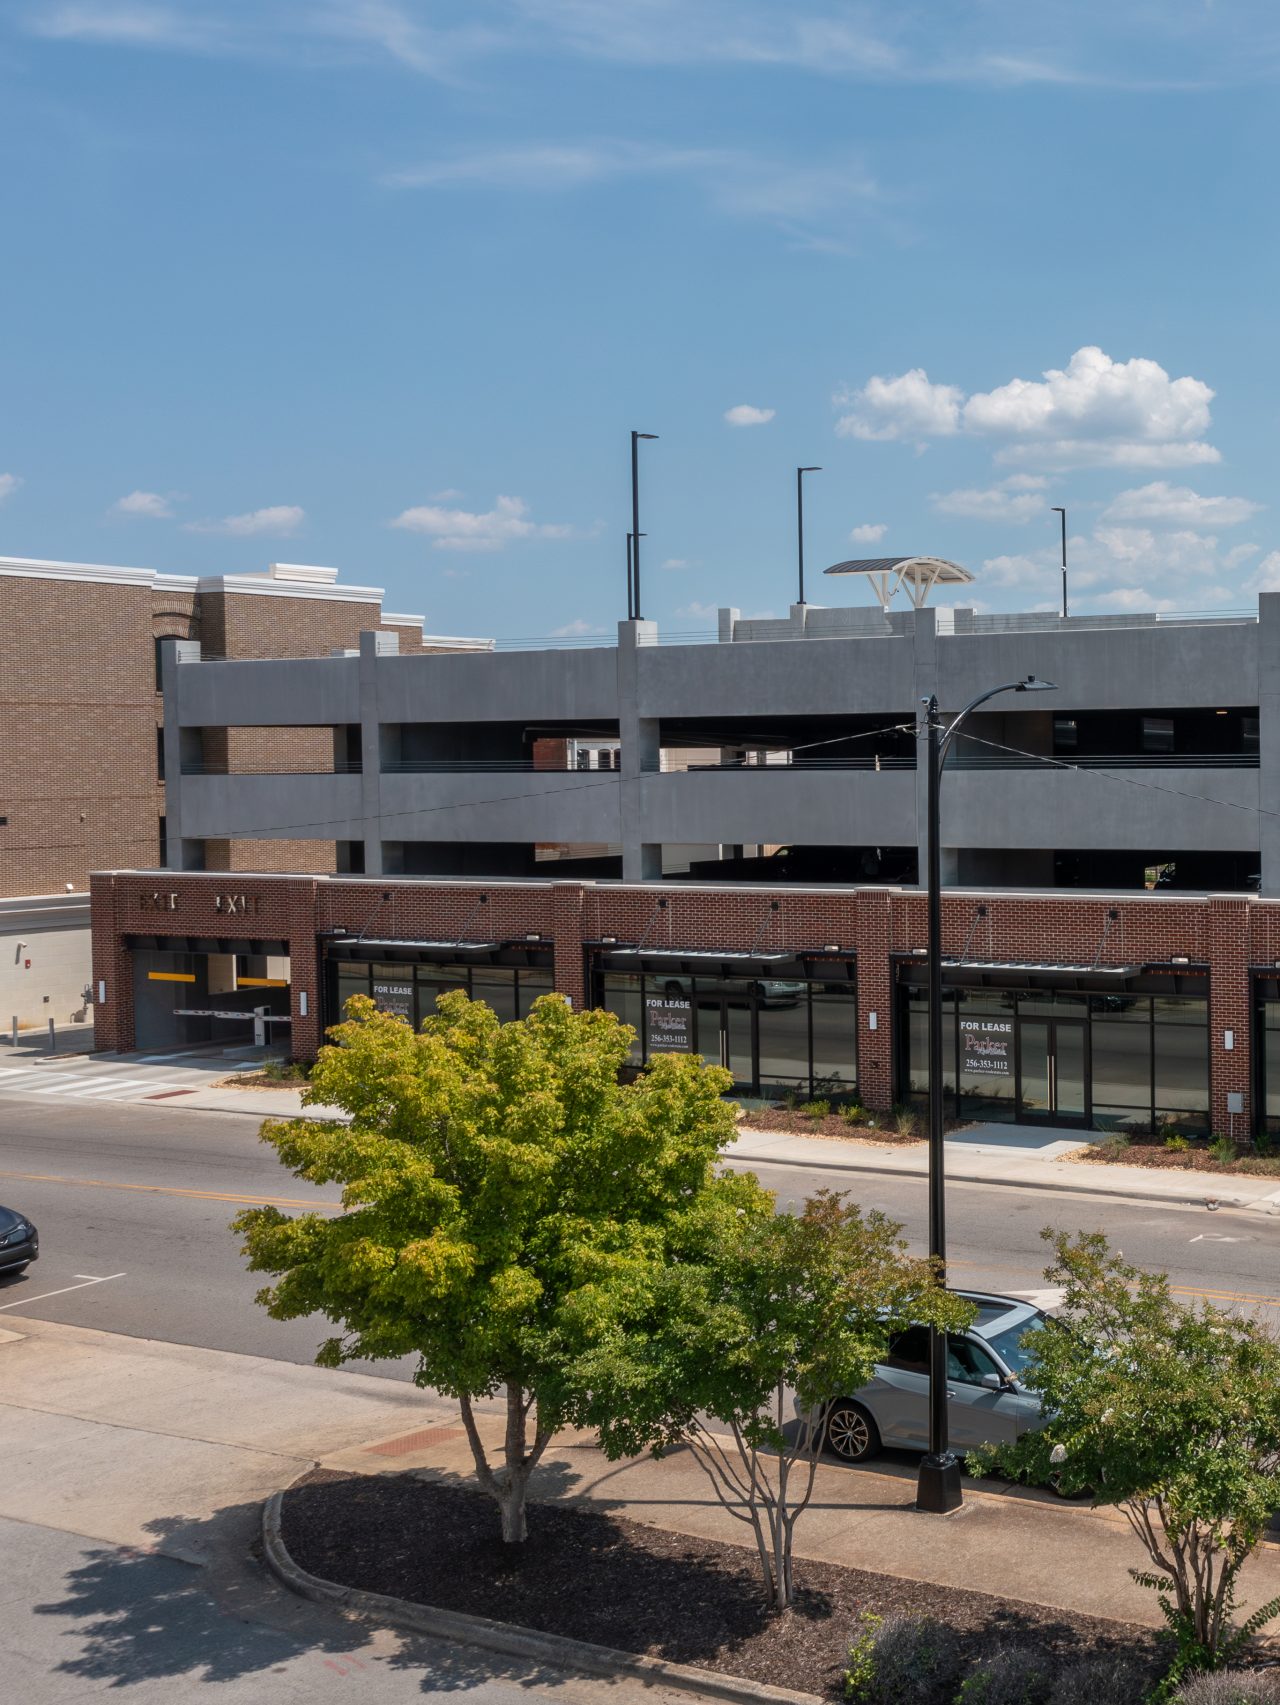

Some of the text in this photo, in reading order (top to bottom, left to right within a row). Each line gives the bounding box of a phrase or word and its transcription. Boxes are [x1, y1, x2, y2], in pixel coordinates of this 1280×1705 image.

[373, 985, 413, 995] FOR LEASE
[646, 999, 691, 1009] FOR LEASE
[650, 1010, 688, 1026] Parker
[960, 1021, 1012, 1032] FOR LEASE
[651, 1034, 687, 1044] 256-353-1112
[964, 1033, 1008, 1051] Parker
[966, 1058, 1008, 1070] 256-353-1112
